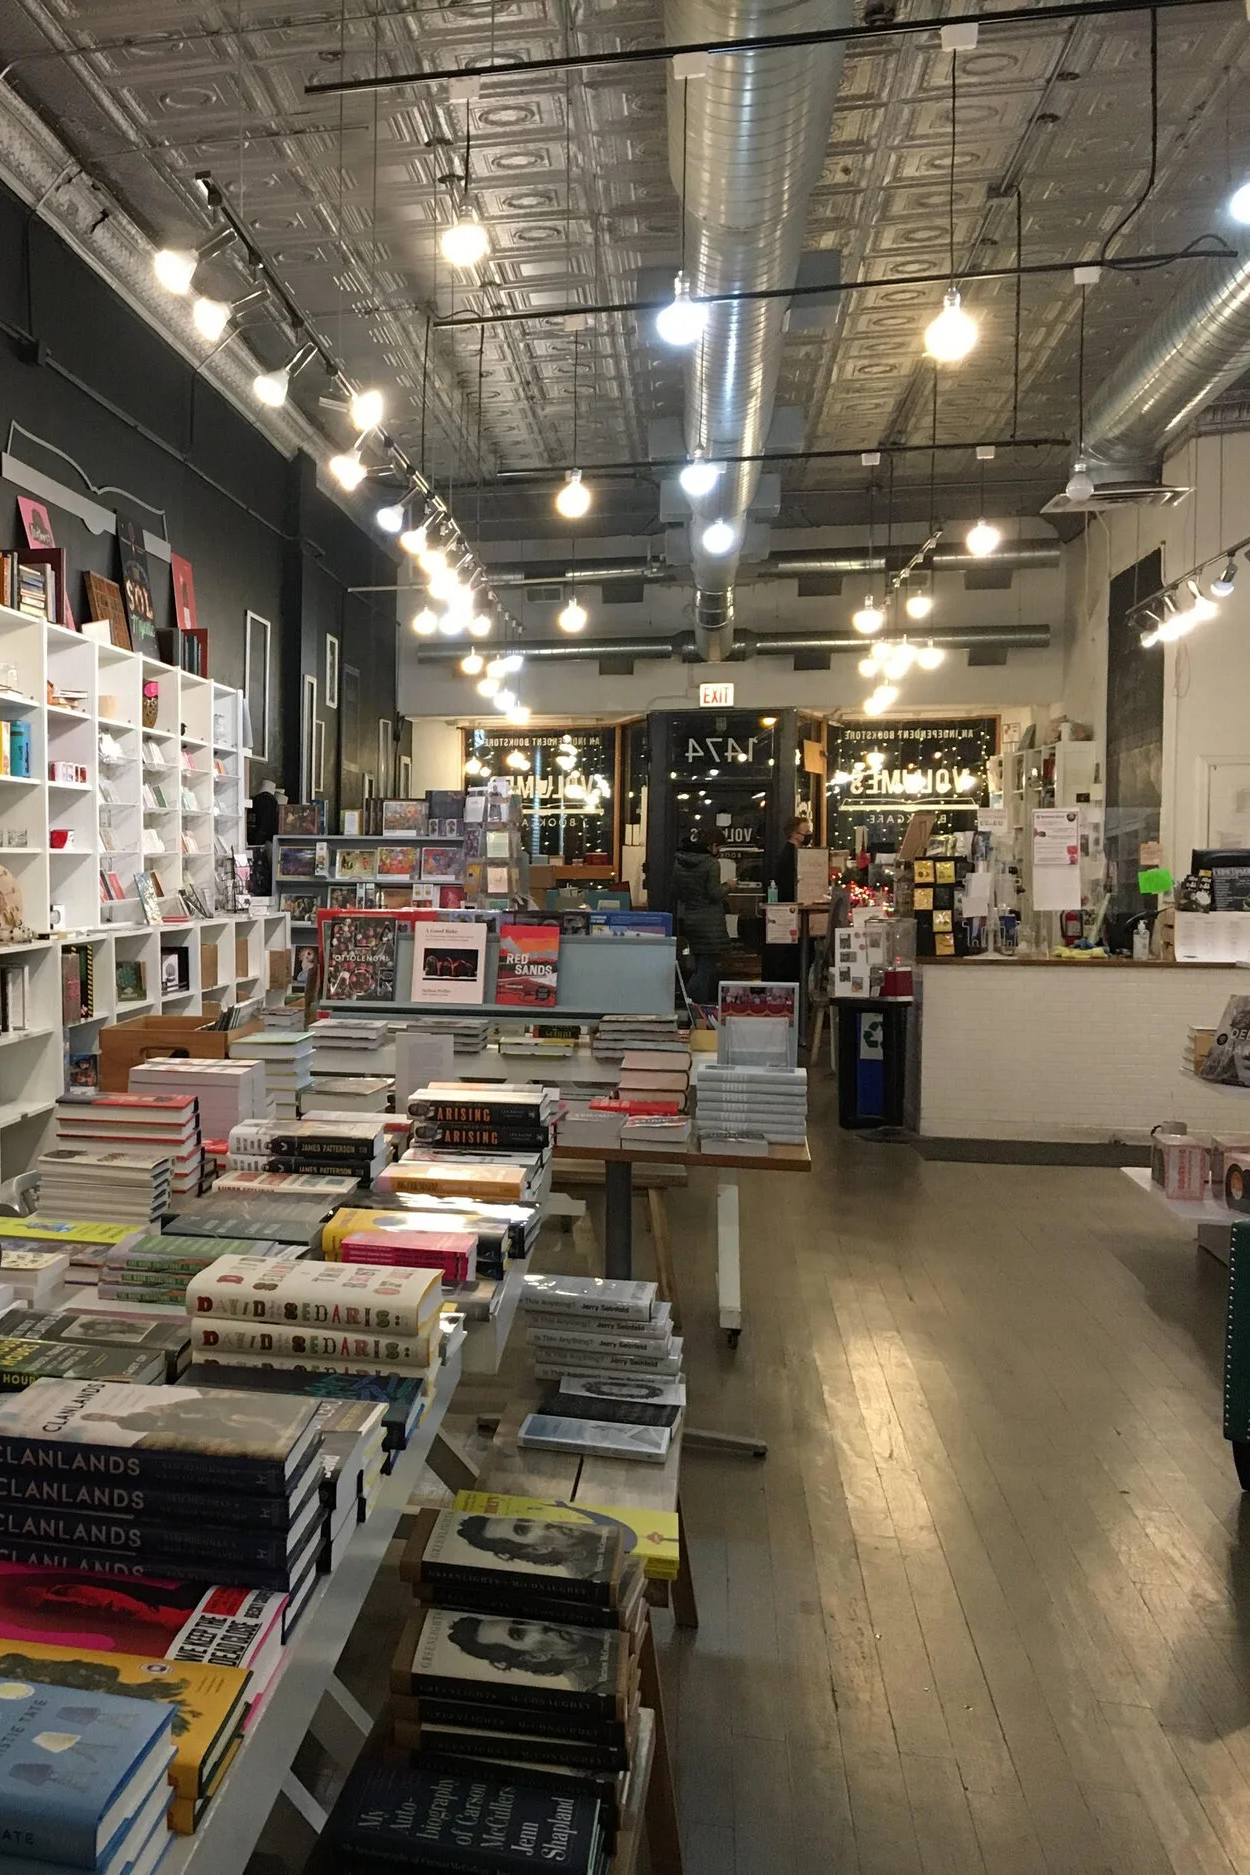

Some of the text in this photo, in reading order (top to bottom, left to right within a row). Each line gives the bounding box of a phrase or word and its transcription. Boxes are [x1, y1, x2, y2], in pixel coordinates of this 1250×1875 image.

[703, 686, 730, 704] EXIT
[506, 953, 530, 965] RED
[514, 964, 553, 976] SANDS
[437, 1107, 491, 1123] ARISING
[444, 1129, 499, 1145] ARISING
[197, 1296, 266, 1318] DAVID
[581, 1303, 630, 1313] Jerry Seinfeld
[596, 1321, 615, 1331] Jerry
[202, 1330, 273, 1351] DAVID
[42, 1382, 106, 1433] CLANLANDS
[427, 1569, 502, 1587] GREENLIGHTS
[174, 1614, 228, 1662] WE KEEP THE
[19, 1699, 48, 1730] TATE
[358, 1806, 391, 1832] My
[389, 1796, 418, 1835] Auto-
[416, 1774, 460, 1842] biography
[451, 1781, 488, 1847] of Carson
[480, 1781, 517, 1851] McCullers
[511, 1821, 540, 1856] Jenn
[541, 1797, 579, 1863] Shapland
